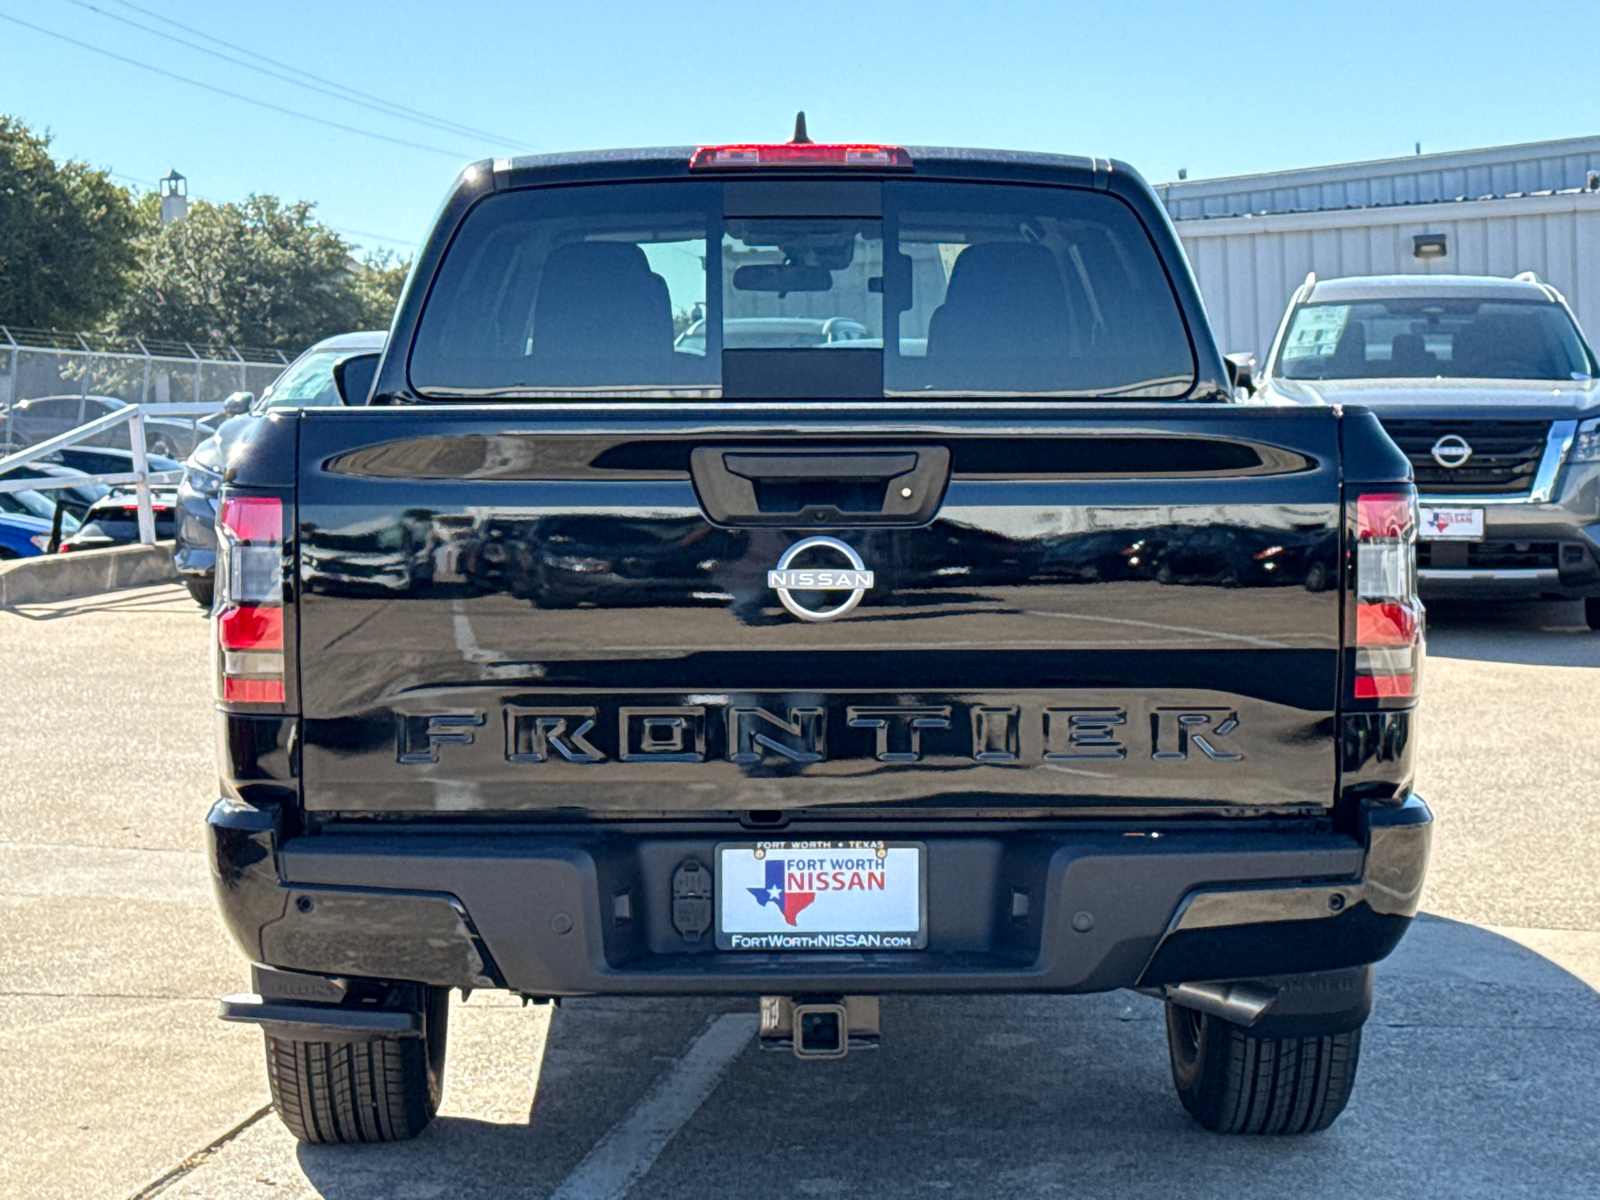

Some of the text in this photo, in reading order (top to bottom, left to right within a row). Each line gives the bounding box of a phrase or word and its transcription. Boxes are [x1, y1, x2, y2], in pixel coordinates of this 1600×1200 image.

[771, 572, 871, 586] NISSAN
[396, 704, 1243, 763] FRONTIER
[757, 840, 885, 849] FORT WORTH TEXAS
[787, 858, 885, 870] FORT WORTH
[787, 872, 885, 890] NISSAN
